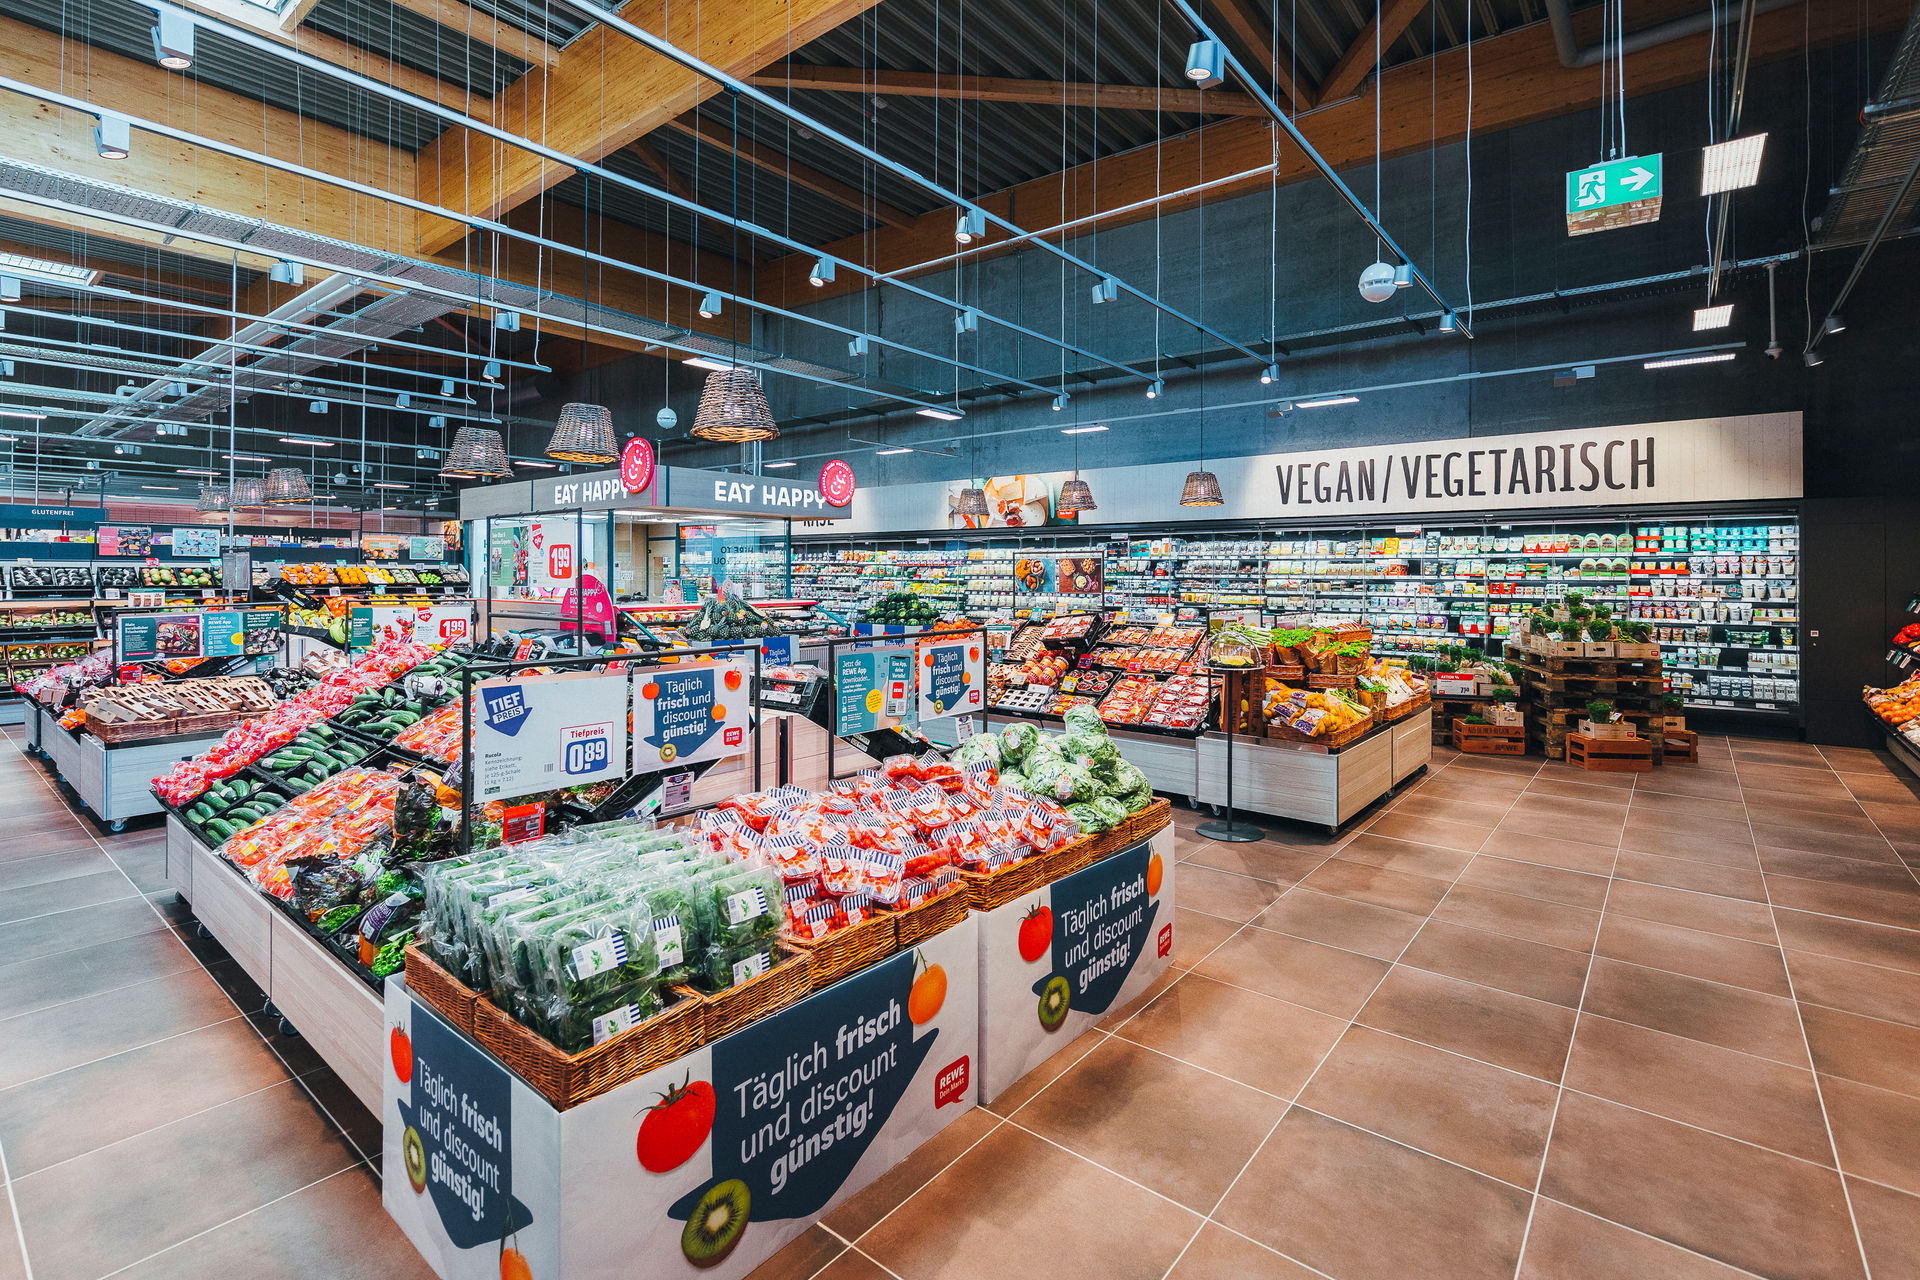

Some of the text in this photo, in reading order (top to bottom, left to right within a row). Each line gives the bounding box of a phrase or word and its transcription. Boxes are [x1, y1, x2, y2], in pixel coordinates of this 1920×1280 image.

[554, 478, 628, 505] EAT HAPPY
[714, 481, 826, 509] EAT HAPPY
[551, 547, 570, 576] 1.99
[569, 597, 587, 605] MOHI
[932, 662, 963, 676] frisch und
[937, 652, 958, 664] Täglich
[842, 667, 867, 676] REWE App
[935, 673, 960, 686] discount
[666, 677, 703, 695] Täglich
[935, 683, 960, 699] günstig!
[489, 691, 521, 713] TIEF
[657, 690, 711, 711] frisch und
[496, 707, 521, 722] PREIS
[662, 707, 707, 725] discount
[570, 727, 605, 738] Tiefpreis
[663, 719, 707, 742] günstig!
[569, 740, 606, 772] 0.89
[1061, 873, 1145, 937] Täglich frisch
[1064, 904, 1143, 969] und discount
[1079, 934, 1131, 995] günstig!
[734, 998, 901, 1119] Täglich frisch
[939, 1063, 965, 1090] REWE
[939, 1077, 965, 1100] Dein Markt
[418, 1057, 502, 1153] Täglich frisch
[741, 1042, 897, 1164] und discount
[420, 1105, 500, 1194] und discount
[770, 1088, 874, 1195] günstig!
[431, 1150, 484, 1222] günstig!
